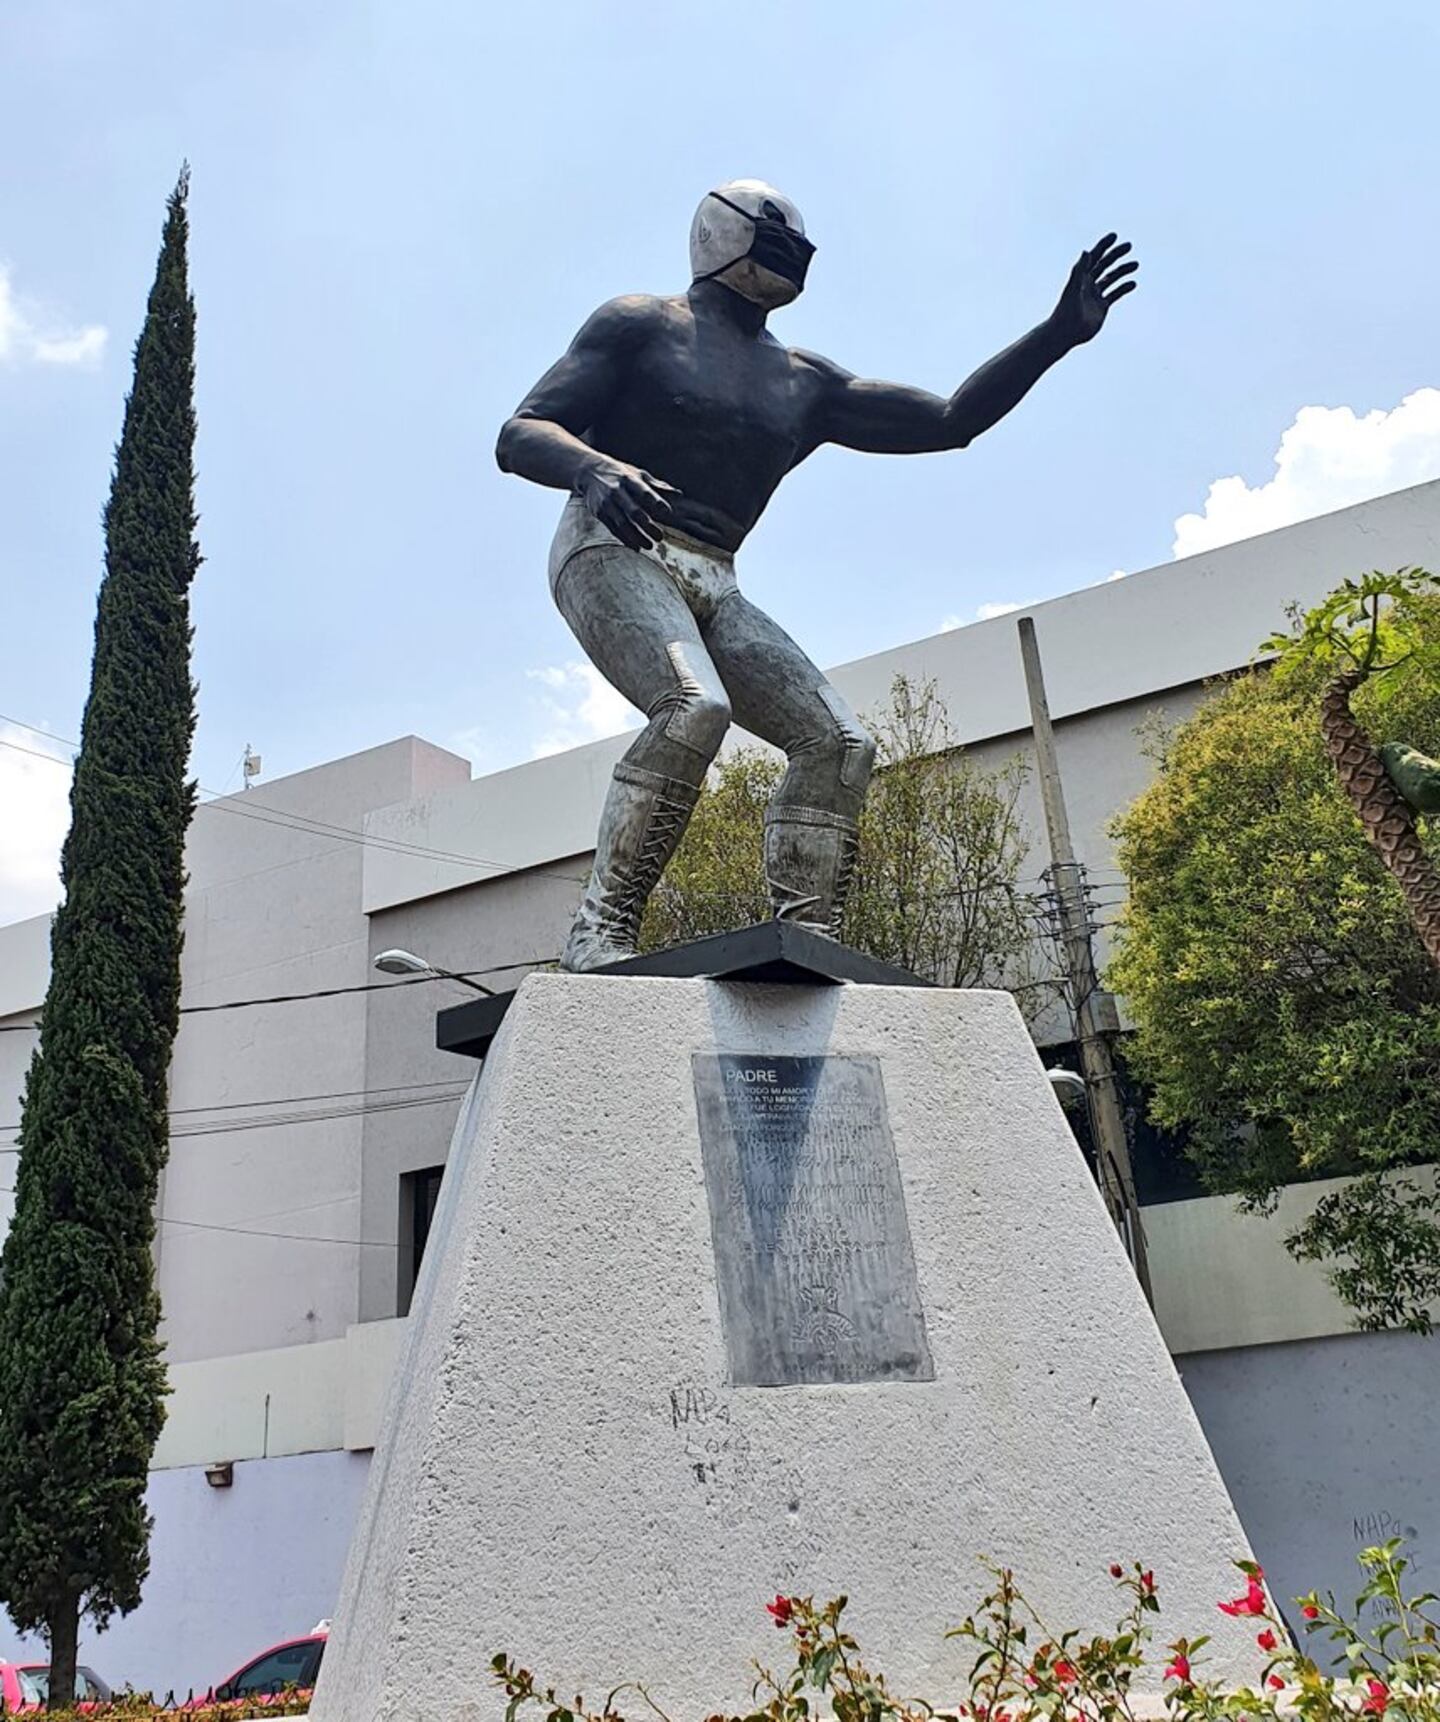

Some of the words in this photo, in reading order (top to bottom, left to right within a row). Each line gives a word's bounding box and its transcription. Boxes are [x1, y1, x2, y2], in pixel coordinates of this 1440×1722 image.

[726, 1069, 778, 1083] PADRE
[745, 1087, 769, 1095] TODO
[770, 1087, 781, 1095] MI
[782, 1087, 808, 1095] AMOR
[762, 1095, 774, 1104] TU
